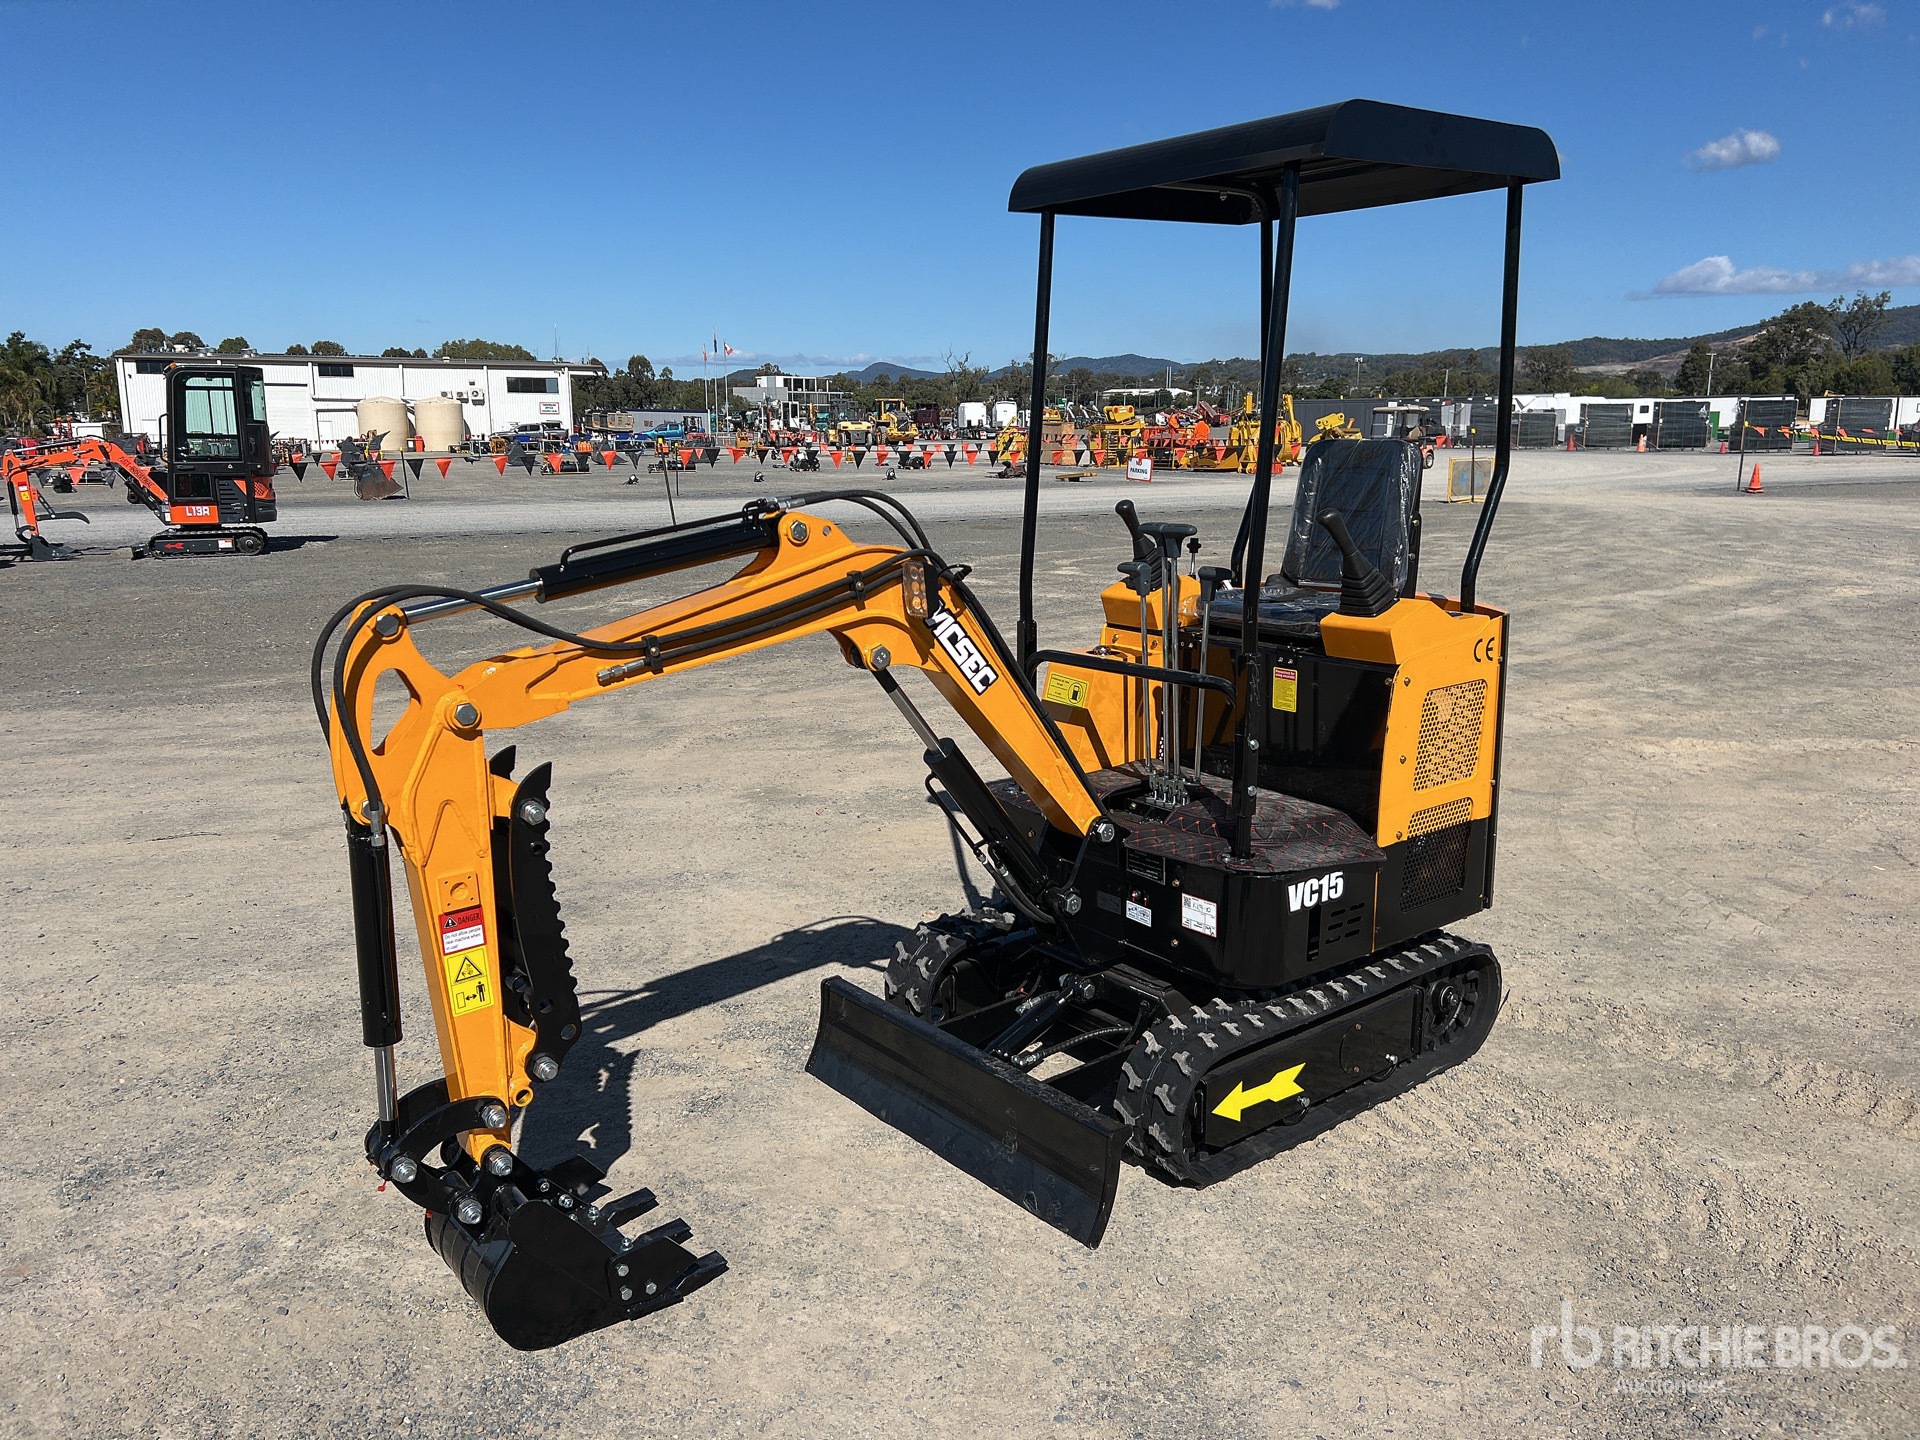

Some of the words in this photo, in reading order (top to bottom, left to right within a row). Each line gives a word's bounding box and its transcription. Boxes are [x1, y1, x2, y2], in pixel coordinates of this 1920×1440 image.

[185, 506, 210, 517] L13R
[1473, 636, 1496, 663] CE
[1288, 871, 1344, 912] VC15
[458, 913, 480, 924] DANGER
